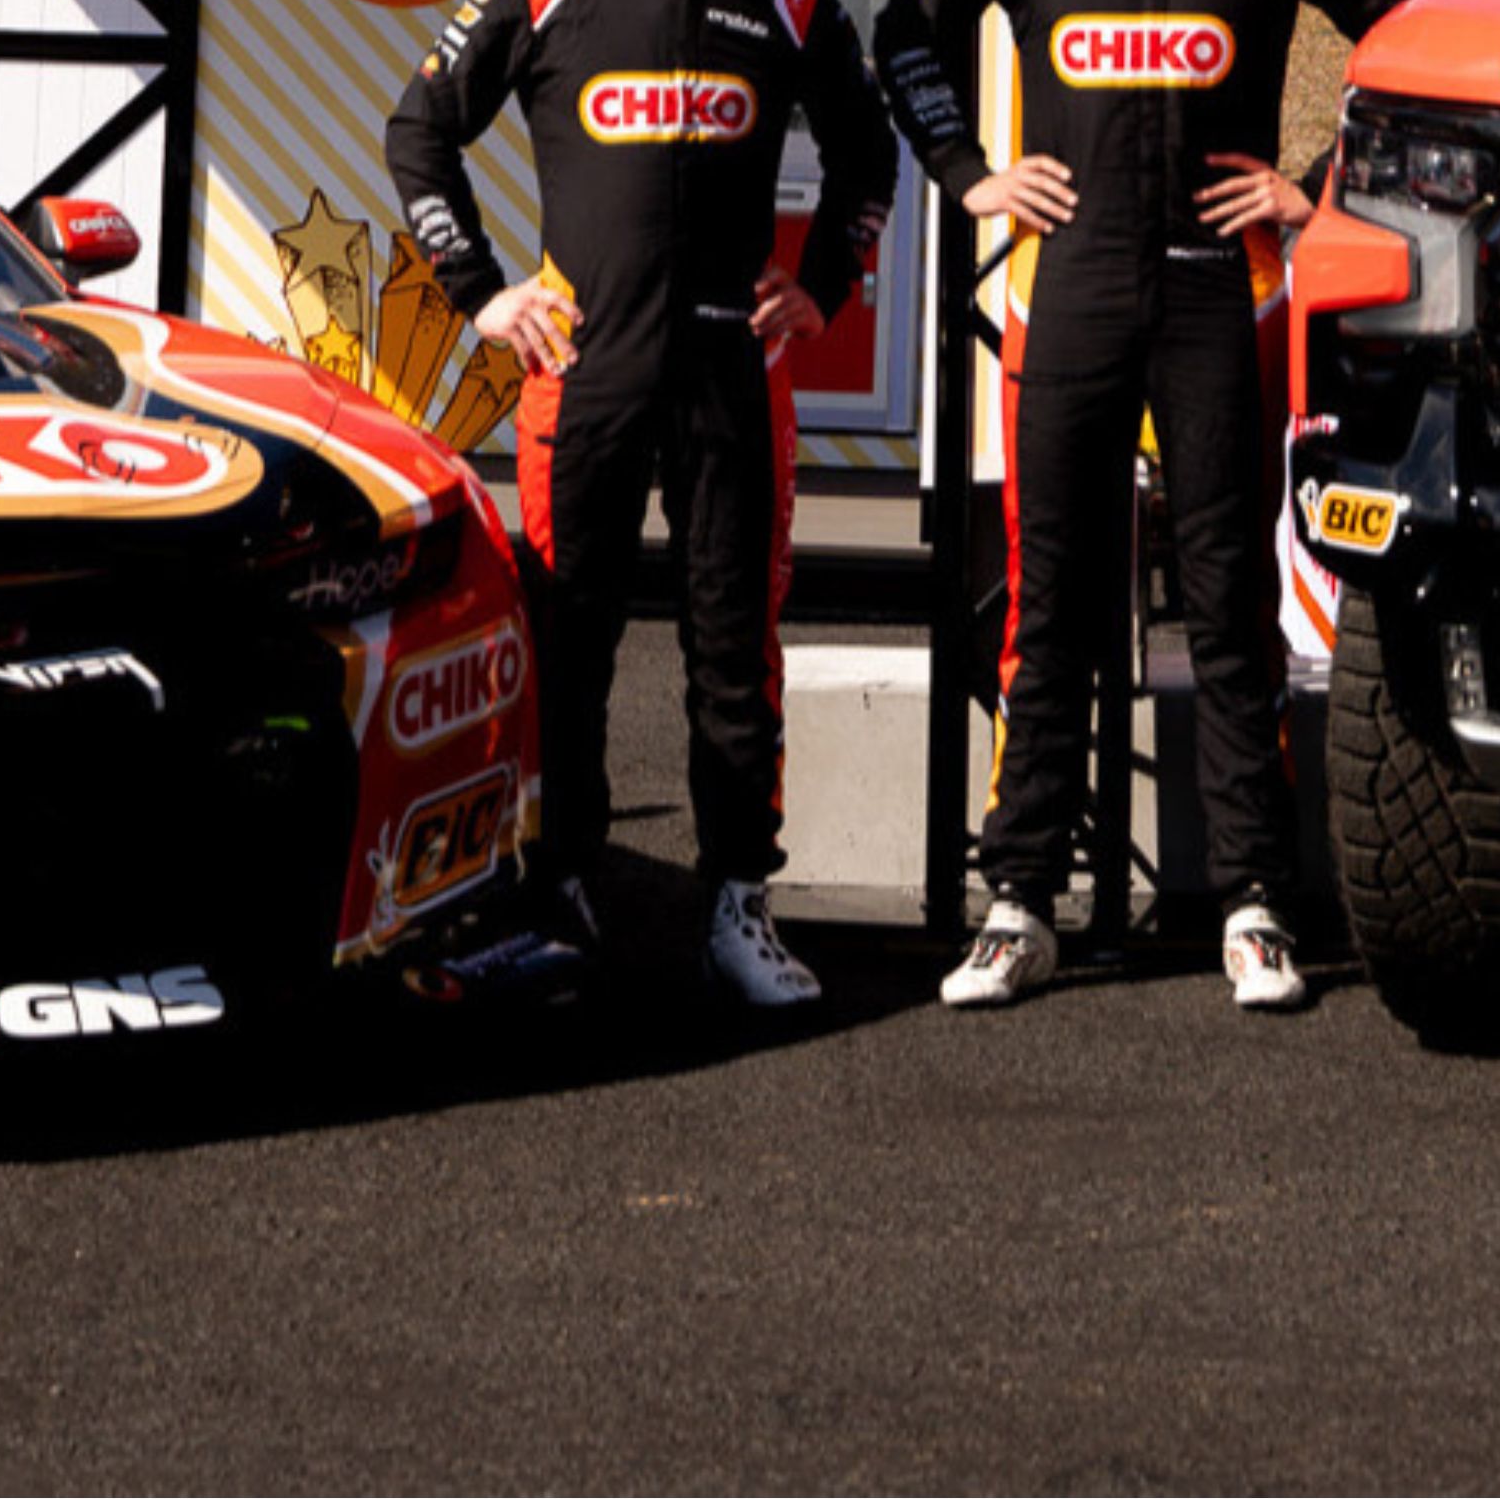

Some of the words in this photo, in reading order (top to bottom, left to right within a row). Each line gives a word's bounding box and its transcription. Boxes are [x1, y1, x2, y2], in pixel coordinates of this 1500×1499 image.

[1061, 28, 1228, 72] CHIKO
[591, 79, 746, 129] CHIKO
[394, 637, 522, 738] CHIKO
